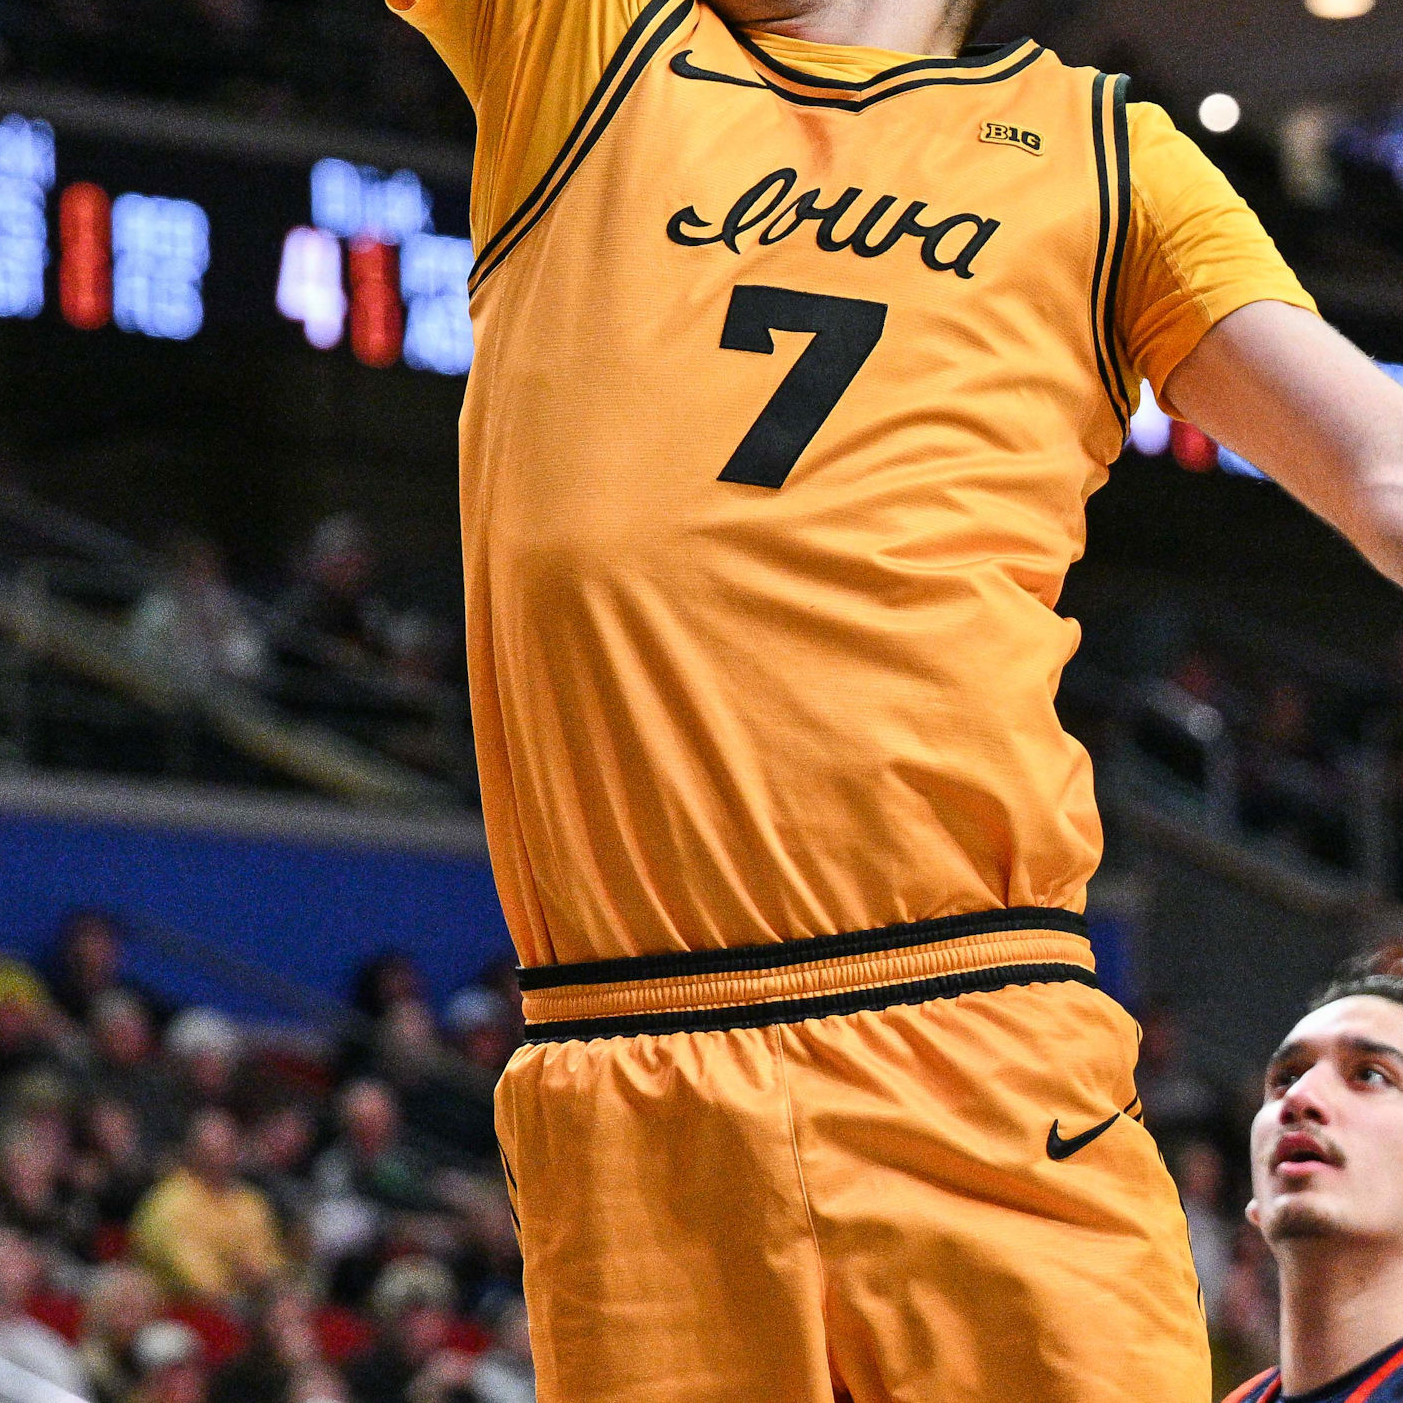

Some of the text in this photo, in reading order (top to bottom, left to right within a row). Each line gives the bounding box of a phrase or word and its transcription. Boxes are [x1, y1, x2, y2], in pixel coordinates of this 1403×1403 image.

[666, 167, 1001, 279] Iowa
[276, 226, 348, 350] 4
[716, 284, 888, 489] 7
